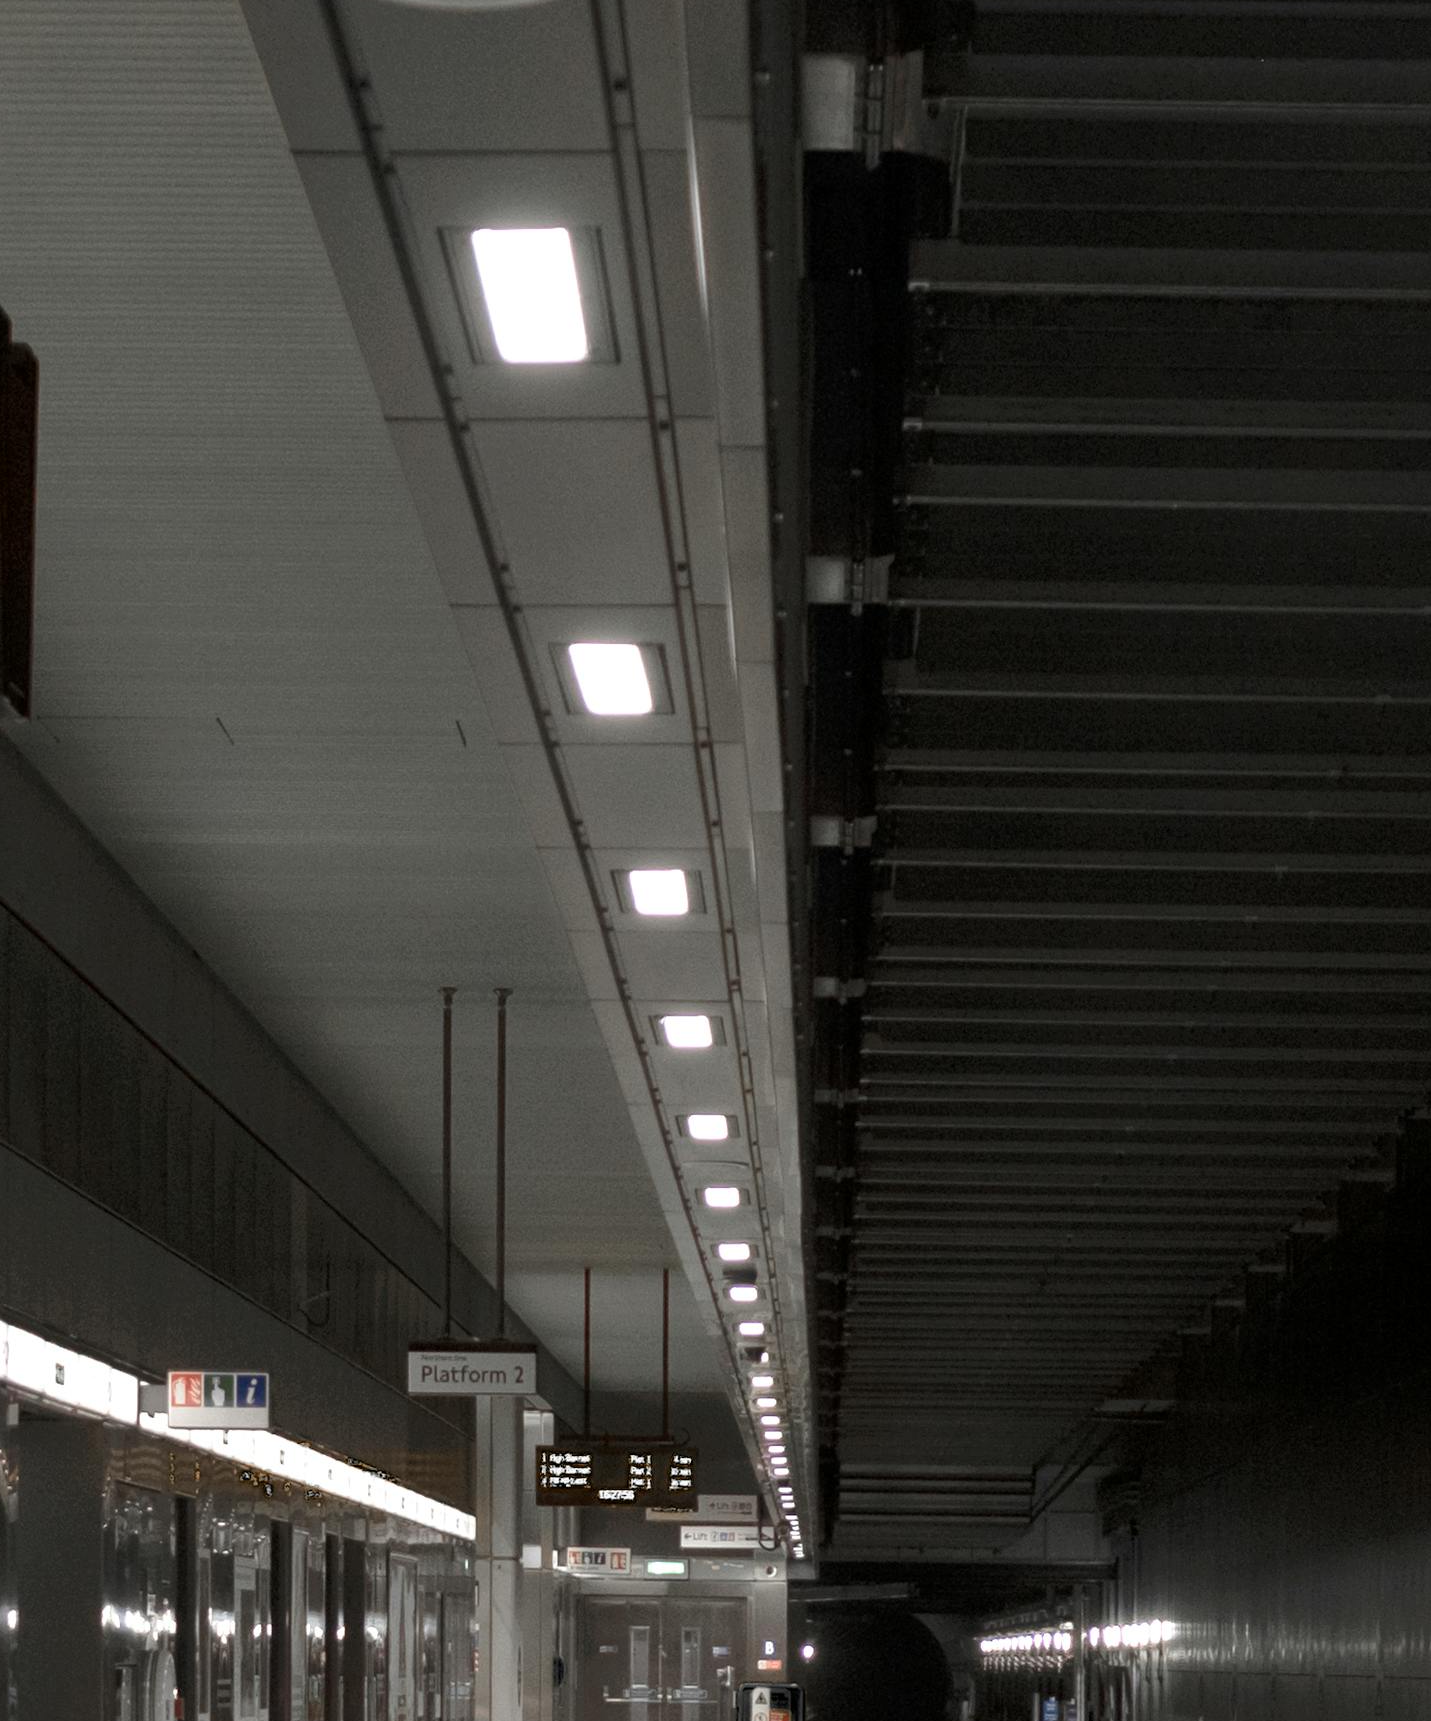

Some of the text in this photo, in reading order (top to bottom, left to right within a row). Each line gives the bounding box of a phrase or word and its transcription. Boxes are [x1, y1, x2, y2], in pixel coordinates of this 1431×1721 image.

[421, 1365, 525, 1384] Platform 2
[764, 1641, 775, 1655] B
